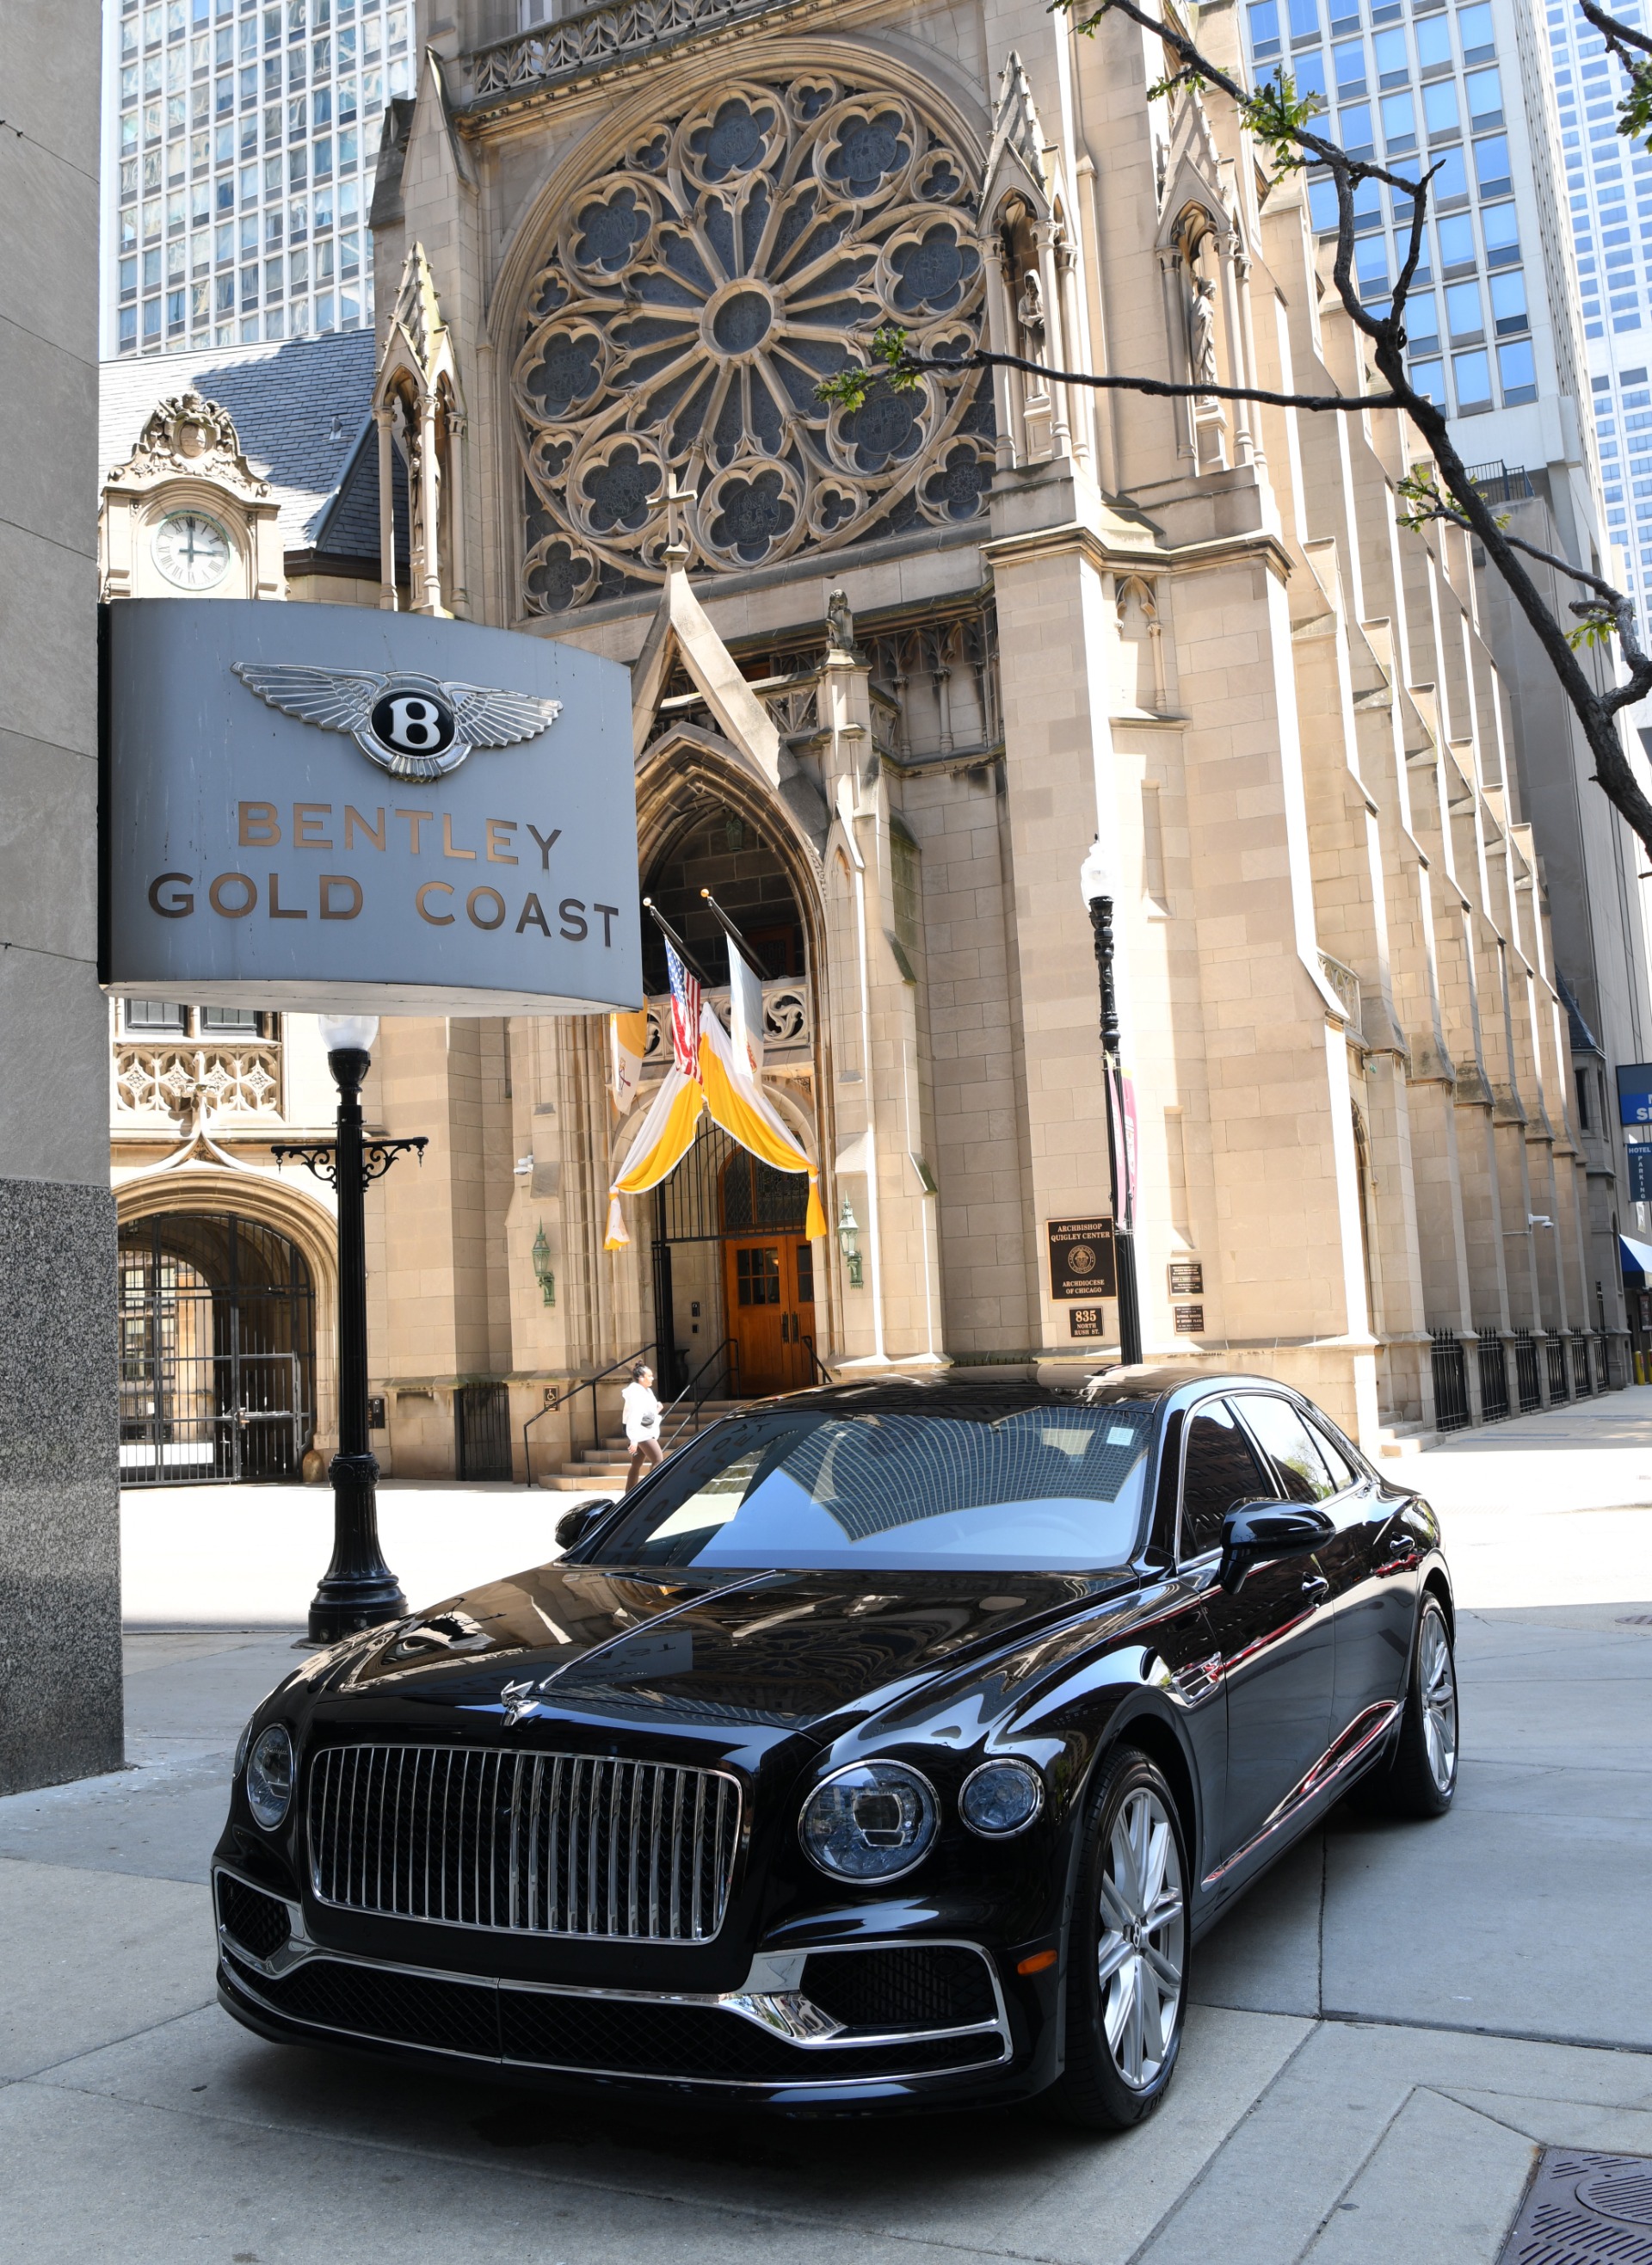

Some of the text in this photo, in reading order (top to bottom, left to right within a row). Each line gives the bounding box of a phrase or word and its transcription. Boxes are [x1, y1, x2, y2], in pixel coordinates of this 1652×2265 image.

[390, 697, 441, 750] B
[237, 800, 563, 871] BENTLEY
[148, 871, 620, 948] GOLD COAST
[1637, 1155, 1646, 1200] PARKING
[1051, 1233, 1082, 1243] QUIGLEY
[1057, 1223, 1102, 1232] ARCHBISHOP
[1062, 1279, 1105, 1287] ARCHDIOCESE
[1076, 1310, 1097, 1323] 835
